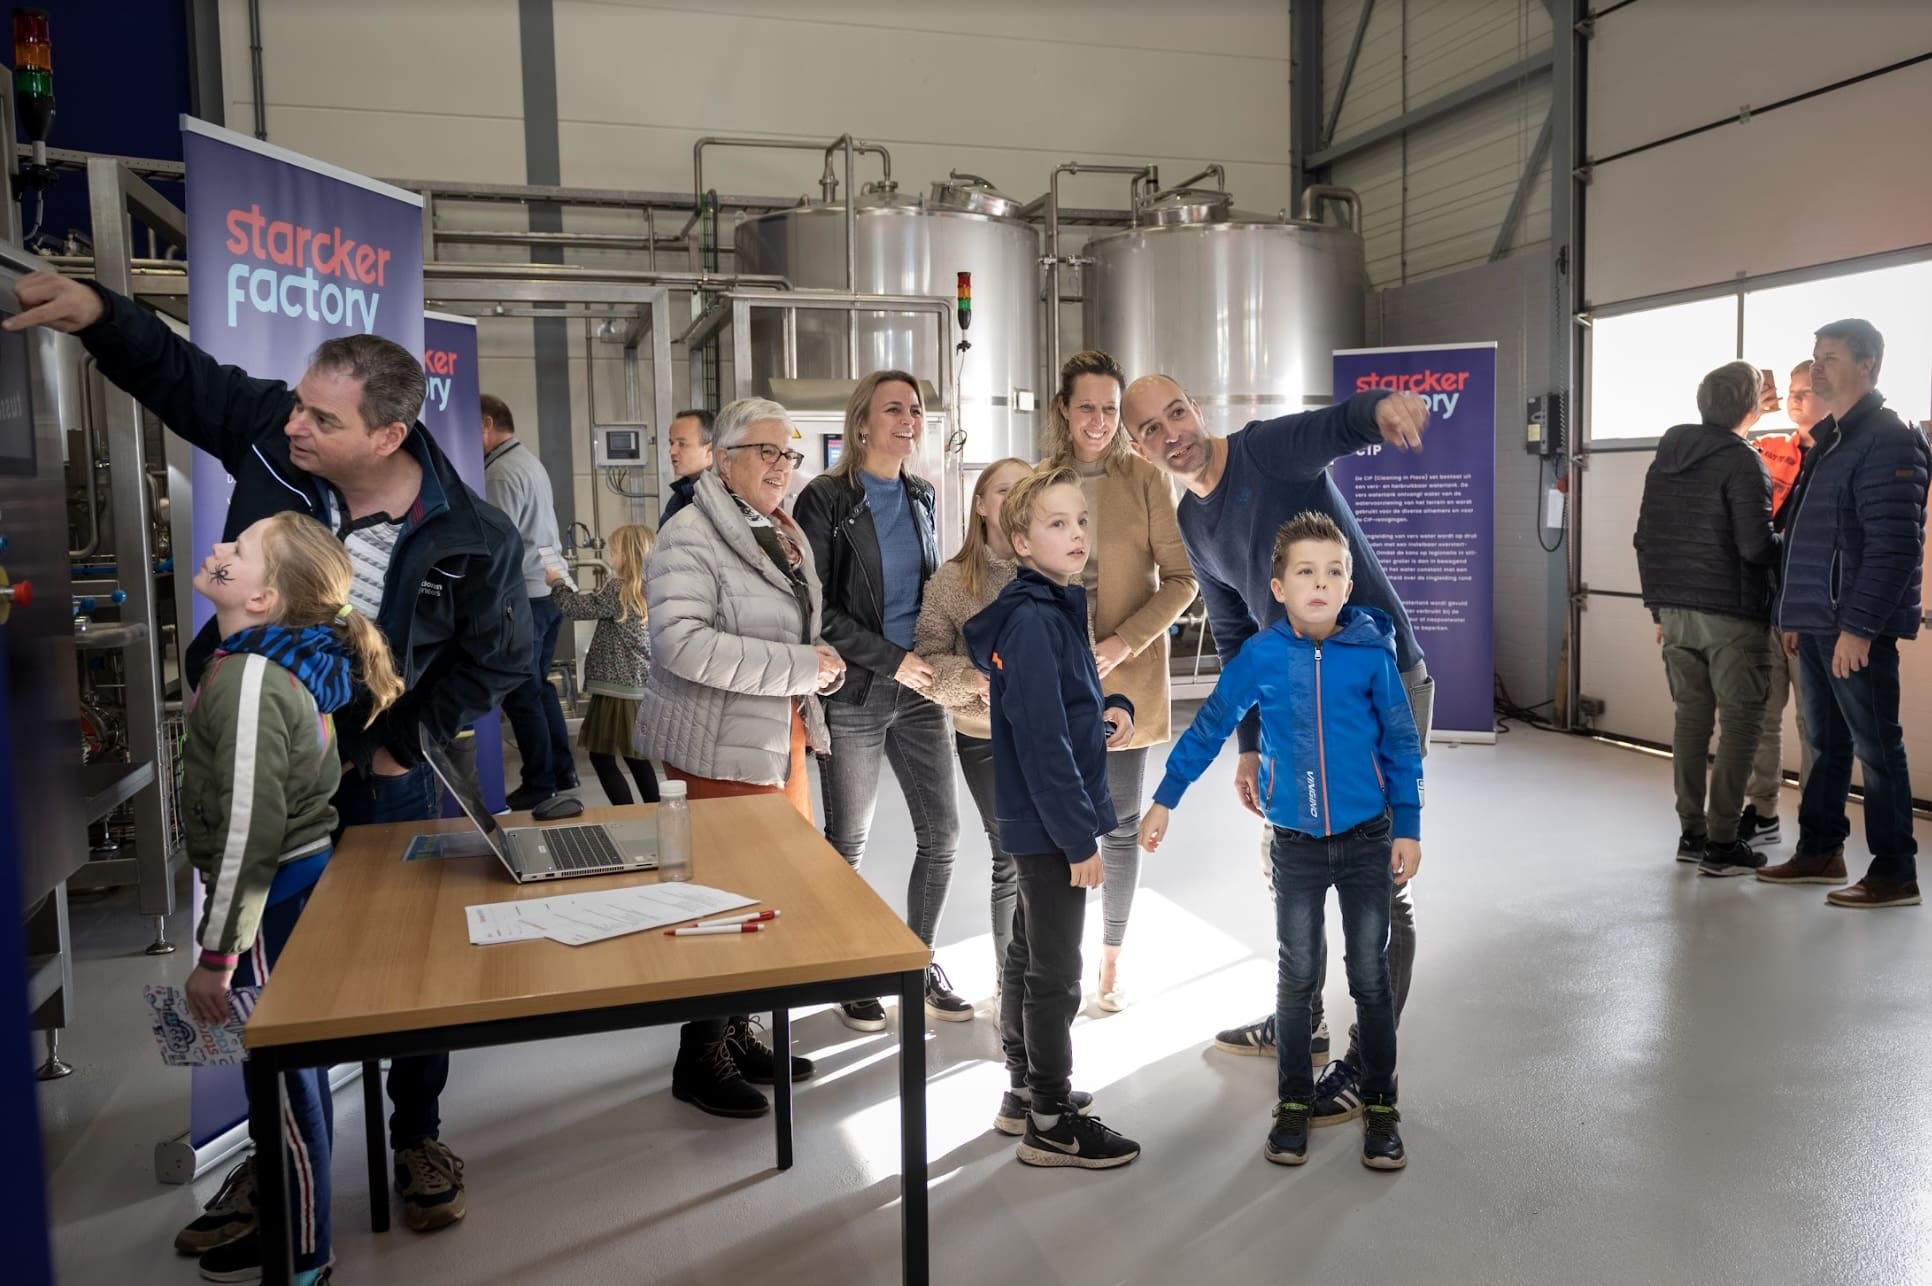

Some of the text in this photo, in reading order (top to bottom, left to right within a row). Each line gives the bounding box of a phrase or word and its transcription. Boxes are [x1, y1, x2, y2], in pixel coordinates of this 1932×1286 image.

[226, 204, 391, 286] starcker
[228, 263, 380, 334] factory
[1356, 370, 1470, 393] starcker
[1306, 770, 1318, 818] VINGINO
